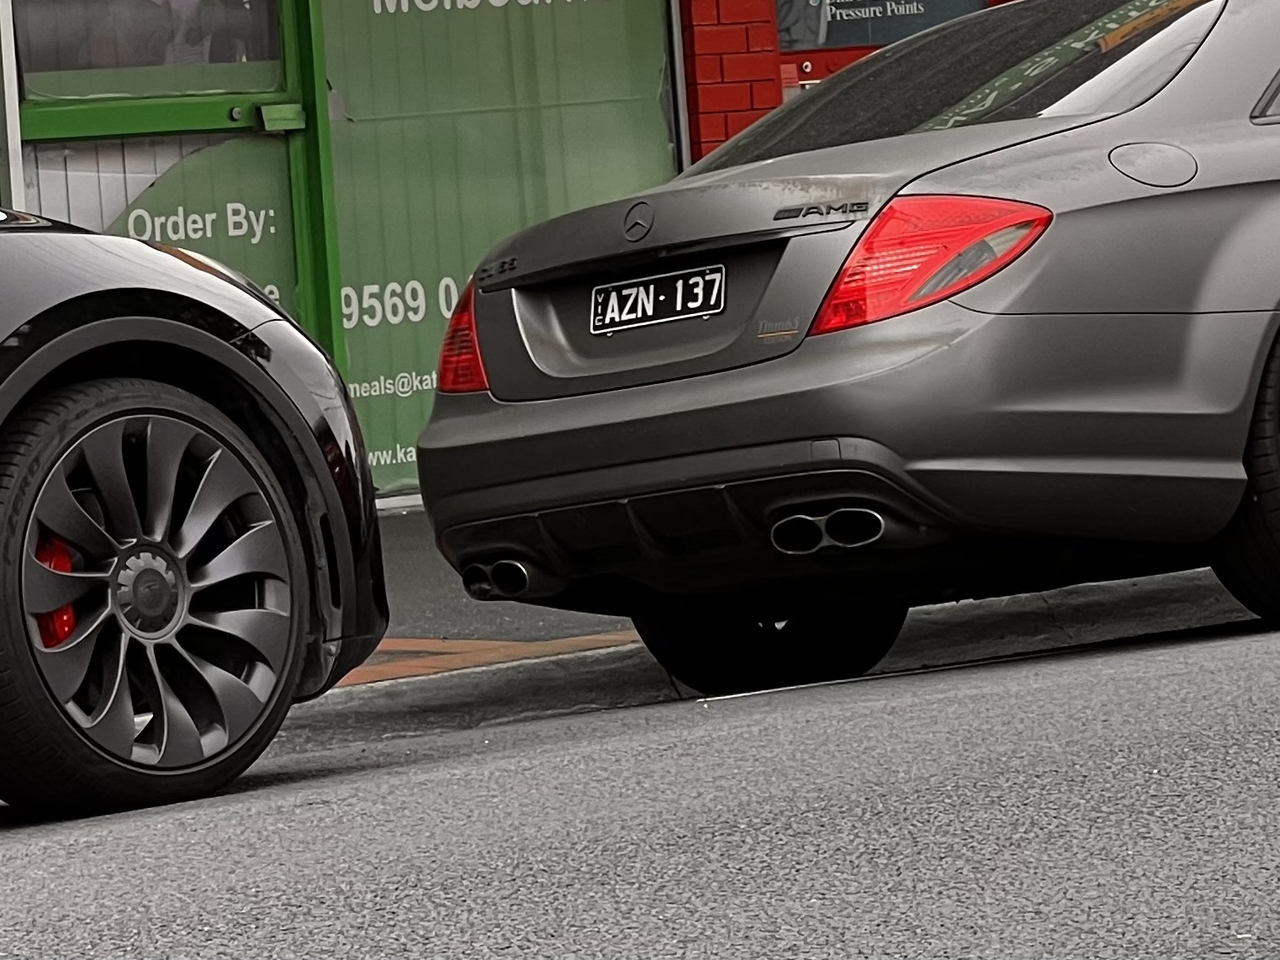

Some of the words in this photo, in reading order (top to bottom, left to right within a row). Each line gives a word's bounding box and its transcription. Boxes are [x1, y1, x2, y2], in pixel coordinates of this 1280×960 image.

[826, 5, 883, 21] Pressure
[886, 0, 925, 16] Points
[128, 206, 217, 242] Order
[226, 202, 276, 244] By:
[802, 202, 869, 218] AMG
[341, 280, 427, 329] 9569
